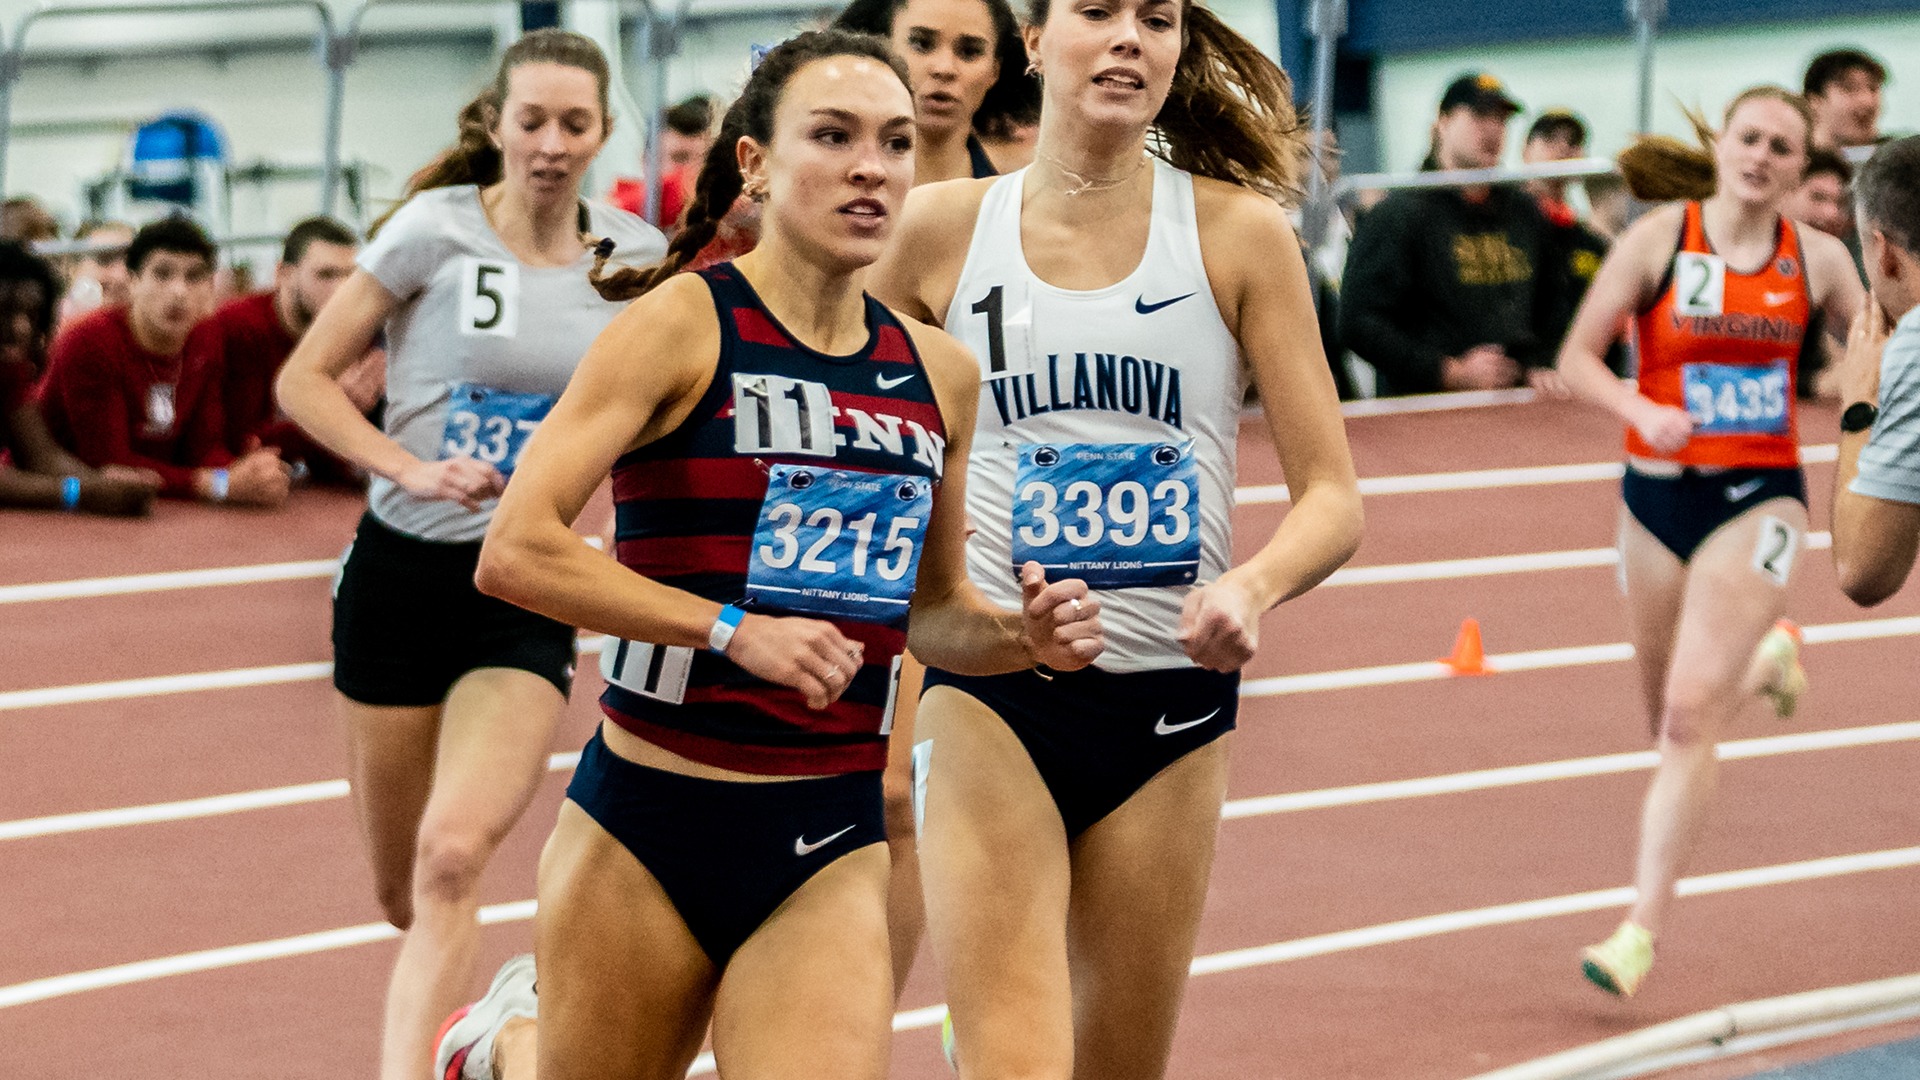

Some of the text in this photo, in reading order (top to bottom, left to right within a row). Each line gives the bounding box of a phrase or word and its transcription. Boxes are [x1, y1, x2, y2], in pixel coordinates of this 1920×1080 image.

[474, 264, 504, 329] 5
[1689, 259, 1711, 308] 2
[972, 285, 1007, 373] 1
[743, 378, 813, 450] 11
[989, 353, 1183, 430] VILLANOVA
[446, 411, 543, 464] 337
[1075, 452, 1136, 461] PENN STATE
[855, 482, 882, 493] STATE
[1019, 480, 1191, 547] 3393
[758, 503, 920, 581] 3215
[1069, 561, 1143, 570] NITTANY LIONS
[1764, 525, 1788, 575] 2
[801, 588, 870, 603] NITTANY LIONS
